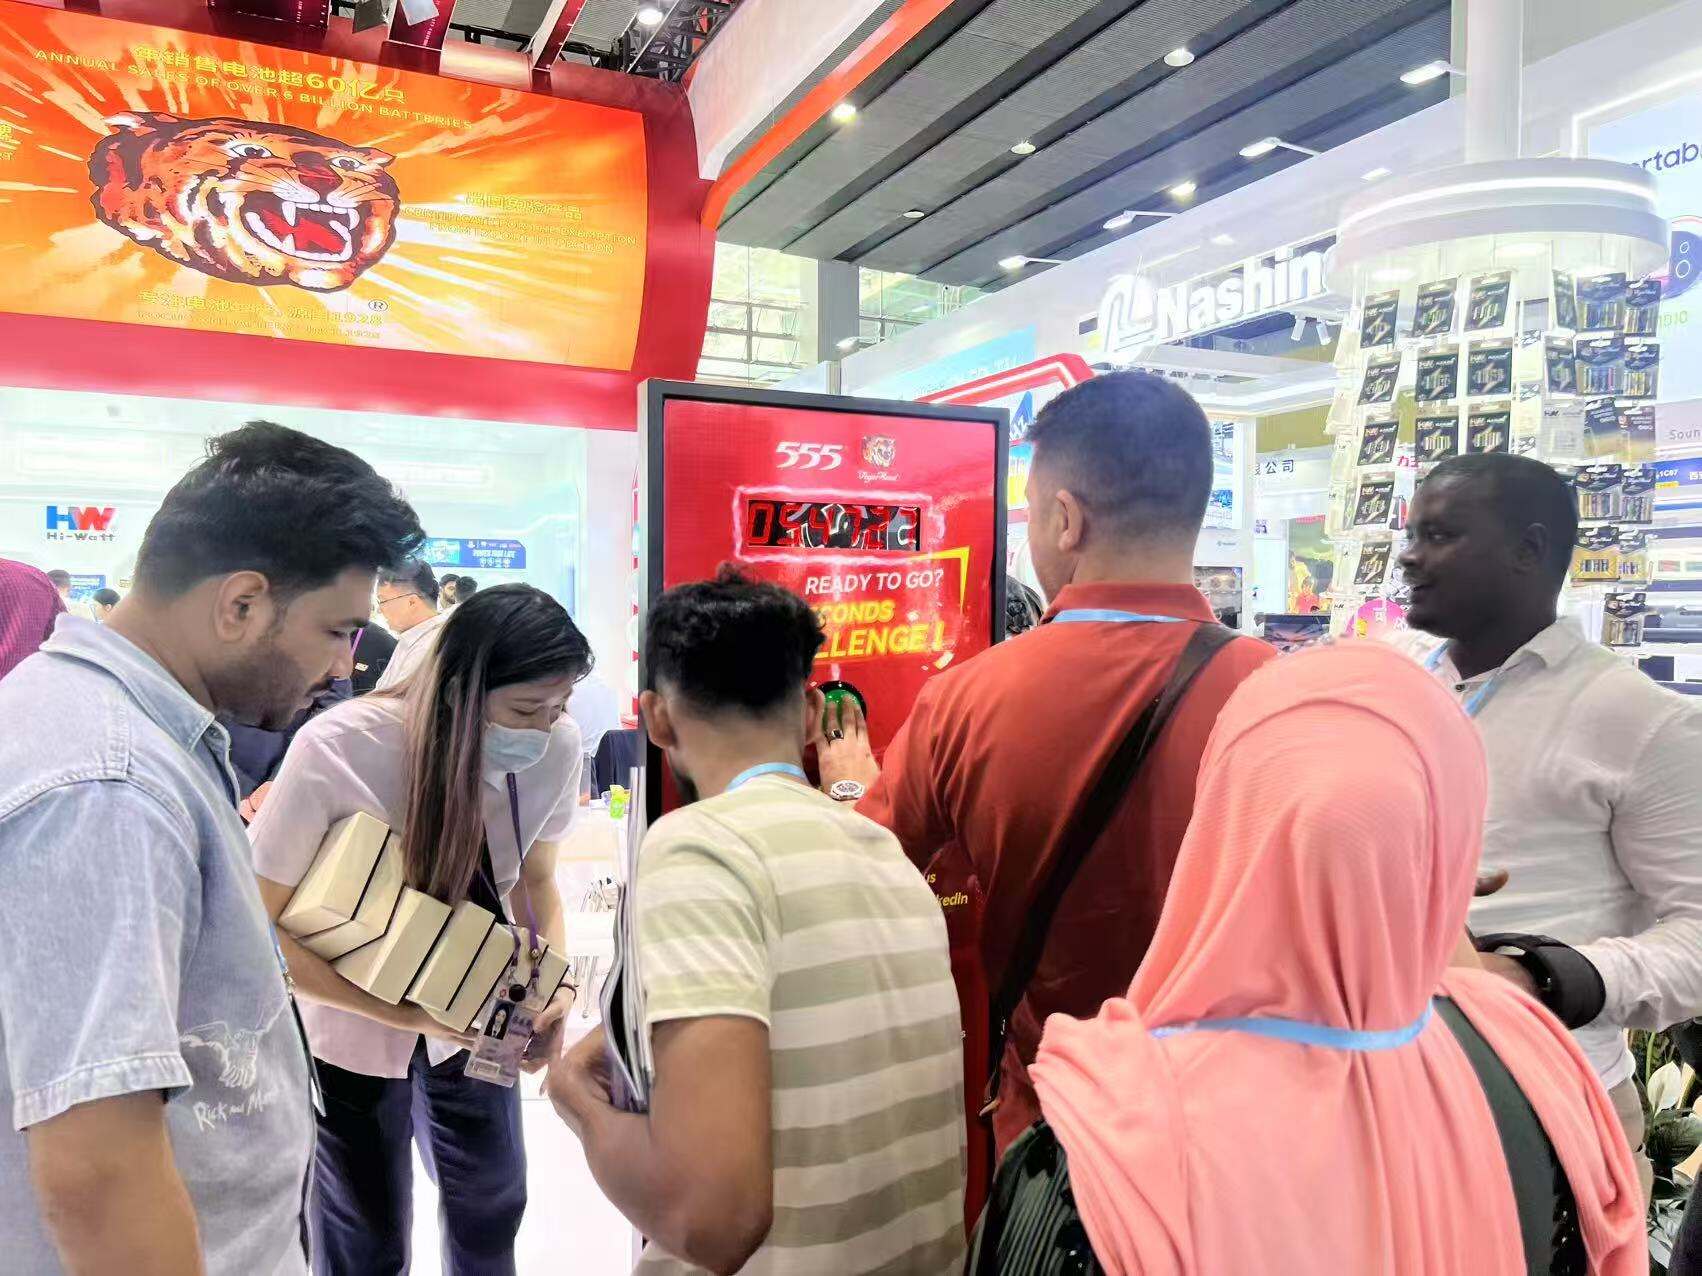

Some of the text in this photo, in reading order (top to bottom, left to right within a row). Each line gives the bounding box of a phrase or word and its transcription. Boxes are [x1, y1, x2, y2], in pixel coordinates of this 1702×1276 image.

[34, 49, 118, 73] ANNUAL
[127, 64, 188, 82] SALES
[195, 75, 221, 89] OF
[225, 80, 279, 98] OVER
[299, 92, 374, 113] BILLION
[378, 106, 474, 131] BATTERIES
[1640, 141, 1702, 172] rtab
[776, 441, 844, 471] 555
[46, 505, 116, 531] HW
[46, 532, 115, 542] Hi-Watt
[804, 568, 944, 595] READY TO GO?
[811, 599, 896, 625] CONDS
[936, 891, 969, 907] kedIn
